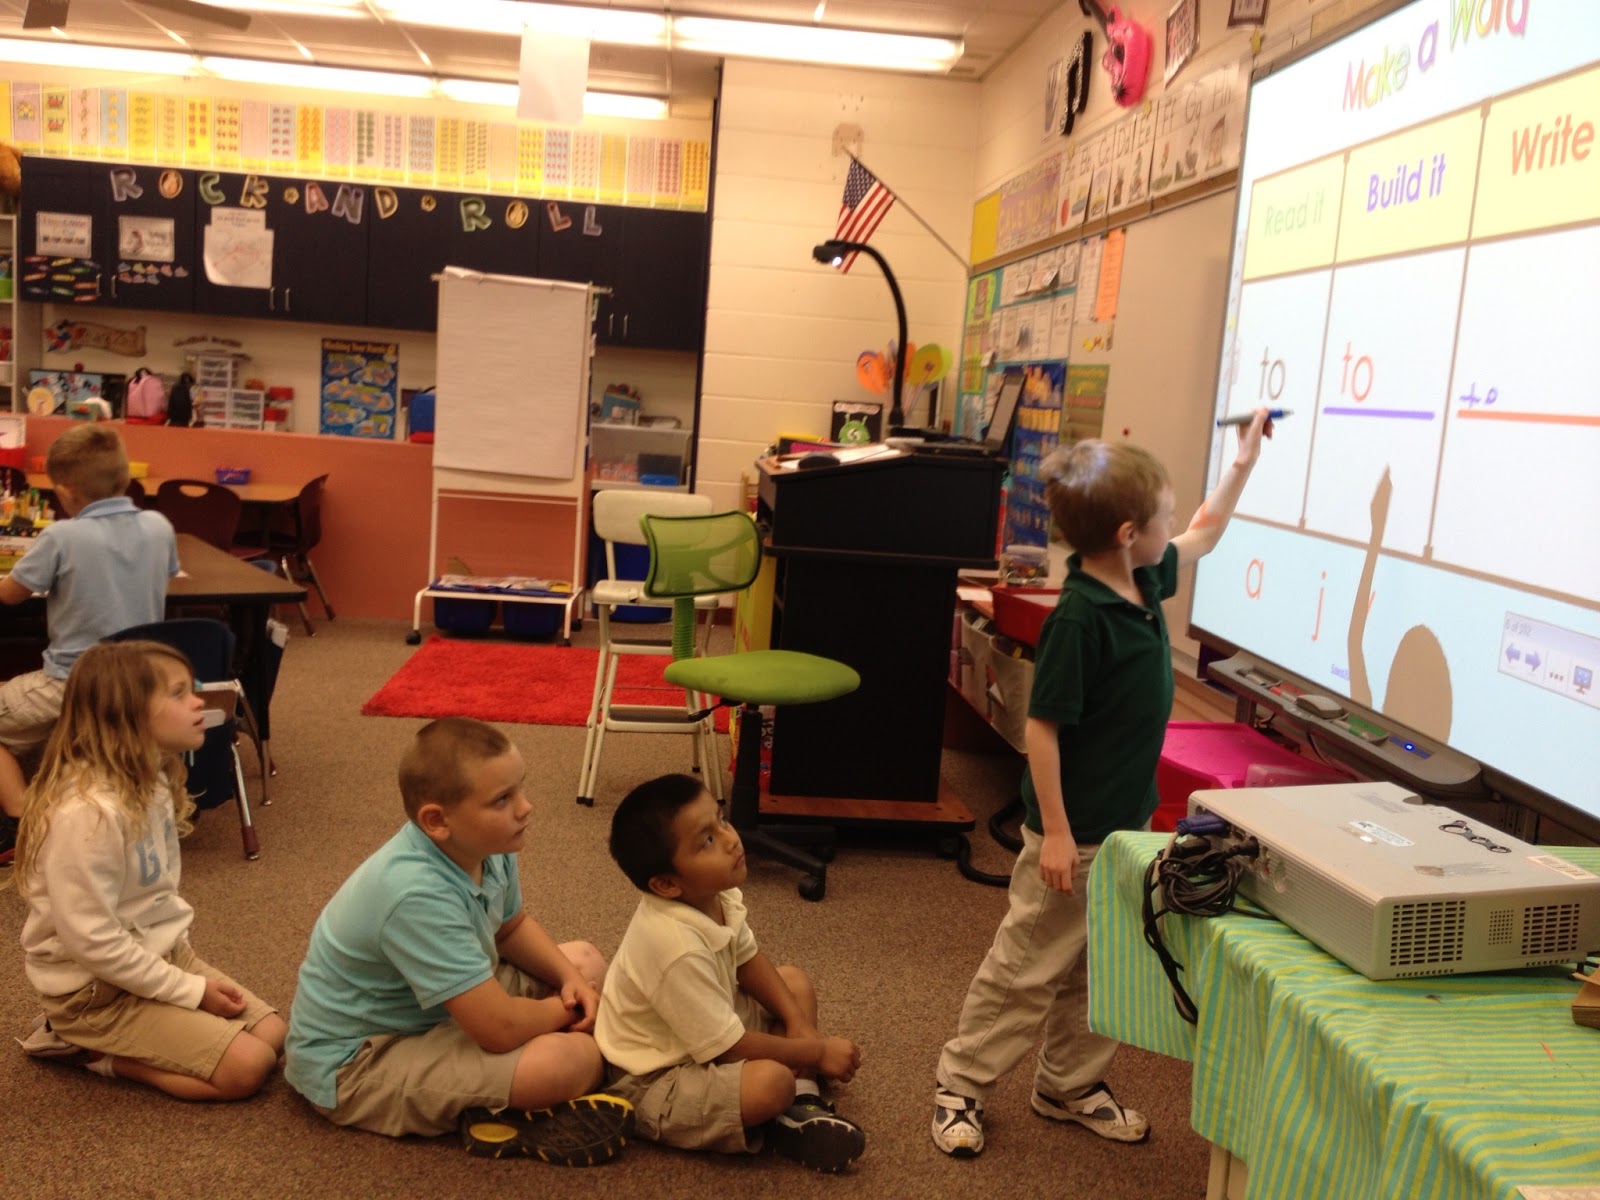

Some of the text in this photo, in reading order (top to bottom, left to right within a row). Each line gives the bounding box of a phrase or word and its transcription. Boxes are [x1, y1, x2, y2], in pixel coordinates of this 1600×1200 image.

[1342, 44, 1411, 112] Make
[1417, 20, 1439, 72] a
[1511, 112, 1595, 176] Write
[110, 166, 602, 237] ROCK AND ROLL
[1366, 152, 1447, 213] Build it
[1263, 190, 1325, 237] Read it
[1259, 345, 1287, 401] to
[1340, 341, 1374, 402] to
[1458, 382, 1499, 408] to
[1245, 558, 1265, 600] a
[1311, 571, 1327, 641] j
